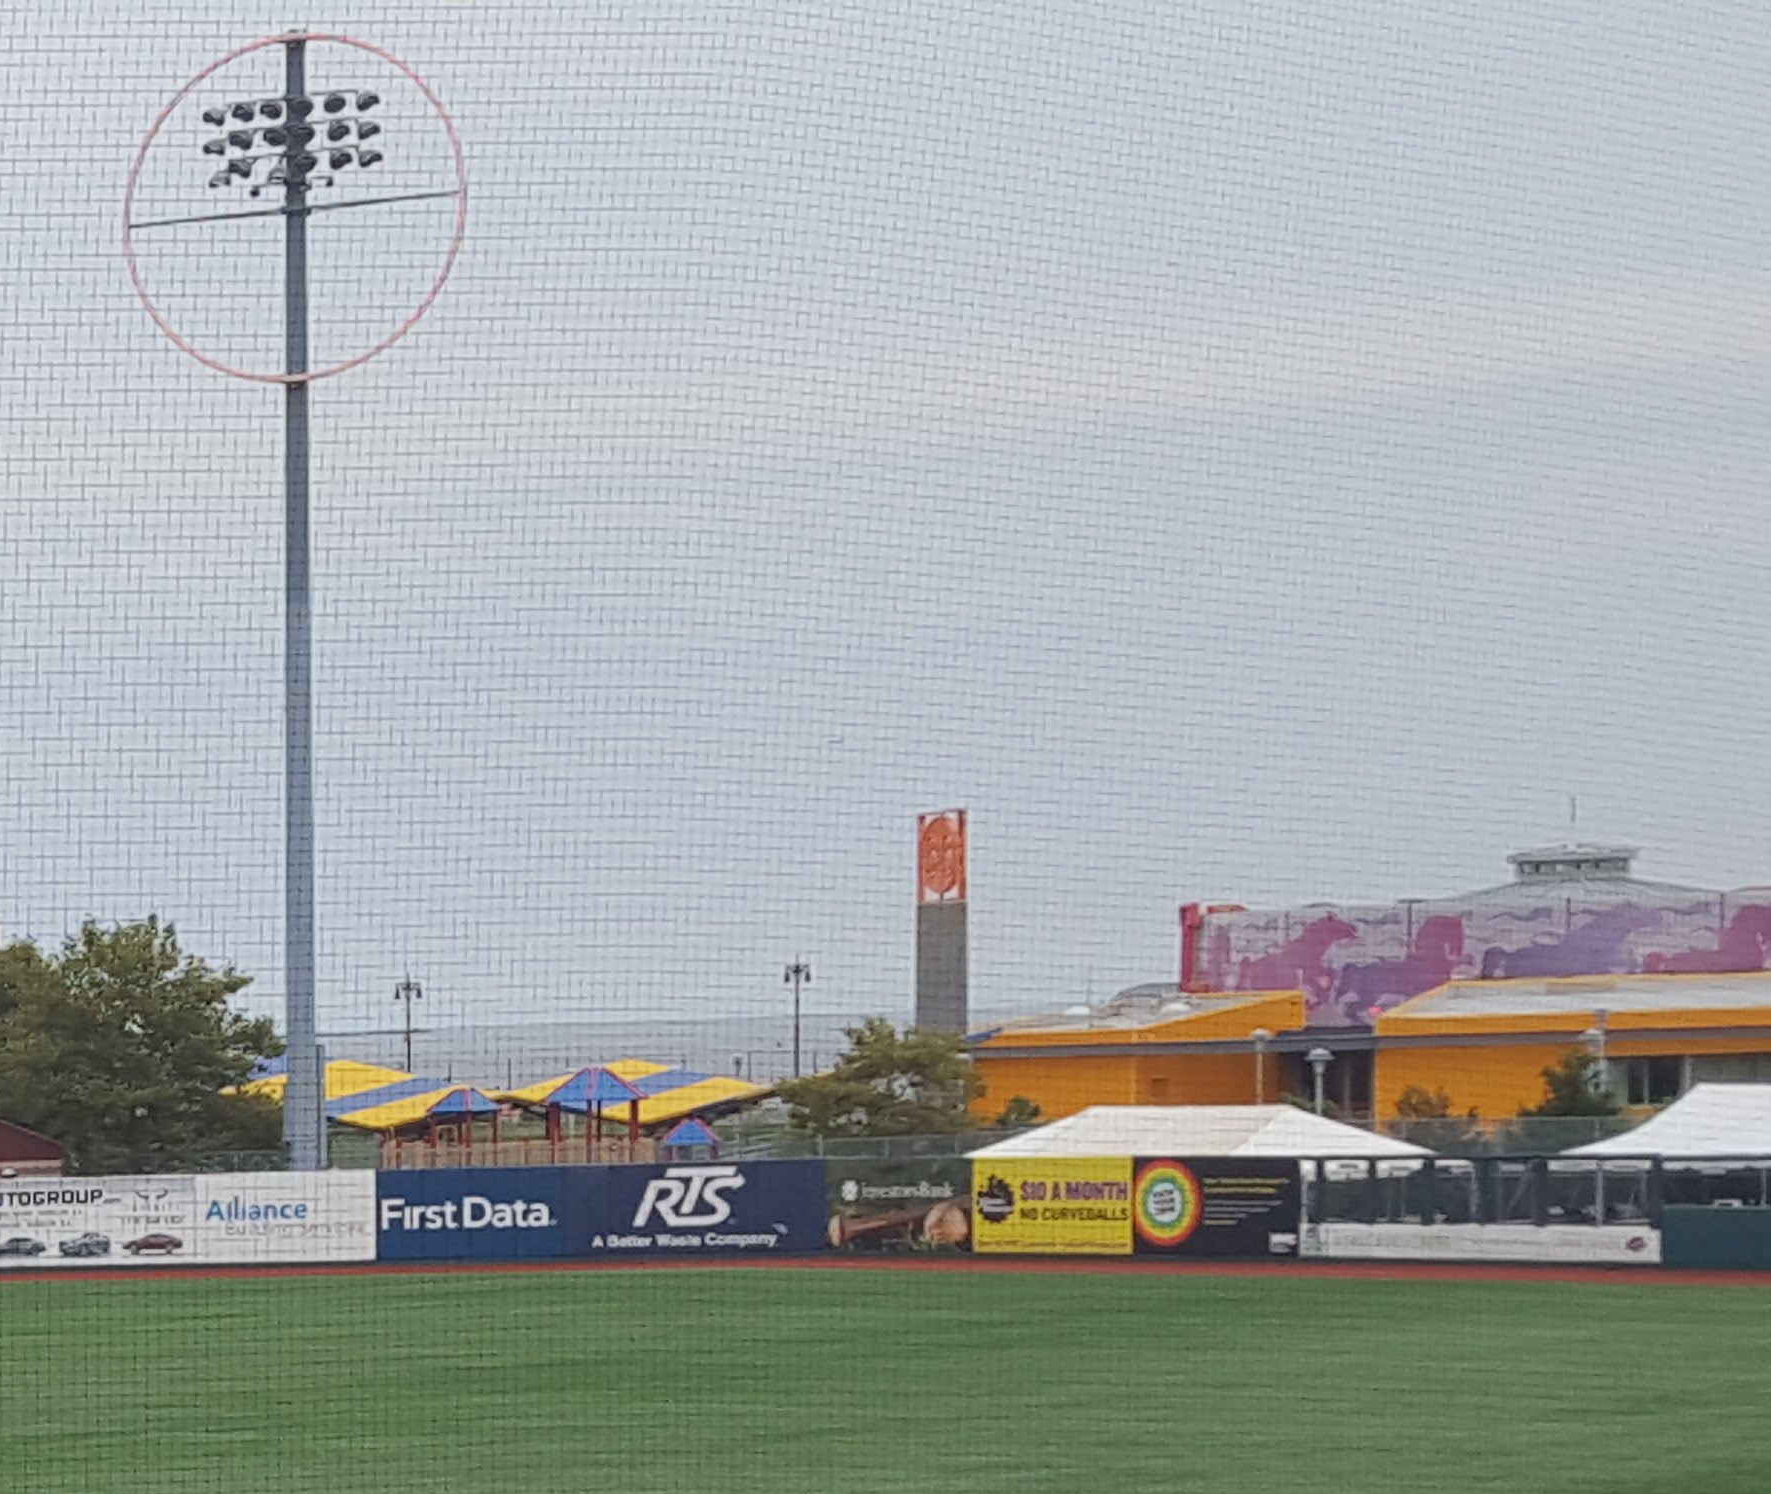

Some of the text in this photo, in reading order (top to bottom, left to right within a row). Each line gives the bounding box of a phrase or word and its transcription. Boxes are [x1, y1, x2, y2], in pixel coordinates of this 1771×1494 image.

[632, 1166, 745, 1228] RTS
[1021, 1181, 1046, 1201] $10
[1066, 1181, 1128, 1200] MONTH
[206, 1199, 308, 1222] Alliance
[381, 1196, 551, 1231] First Data
[1042, 1207, 1129, 1221] CURVEBALLS
[592, 1232, 778, 1249] A Better Waste Company
